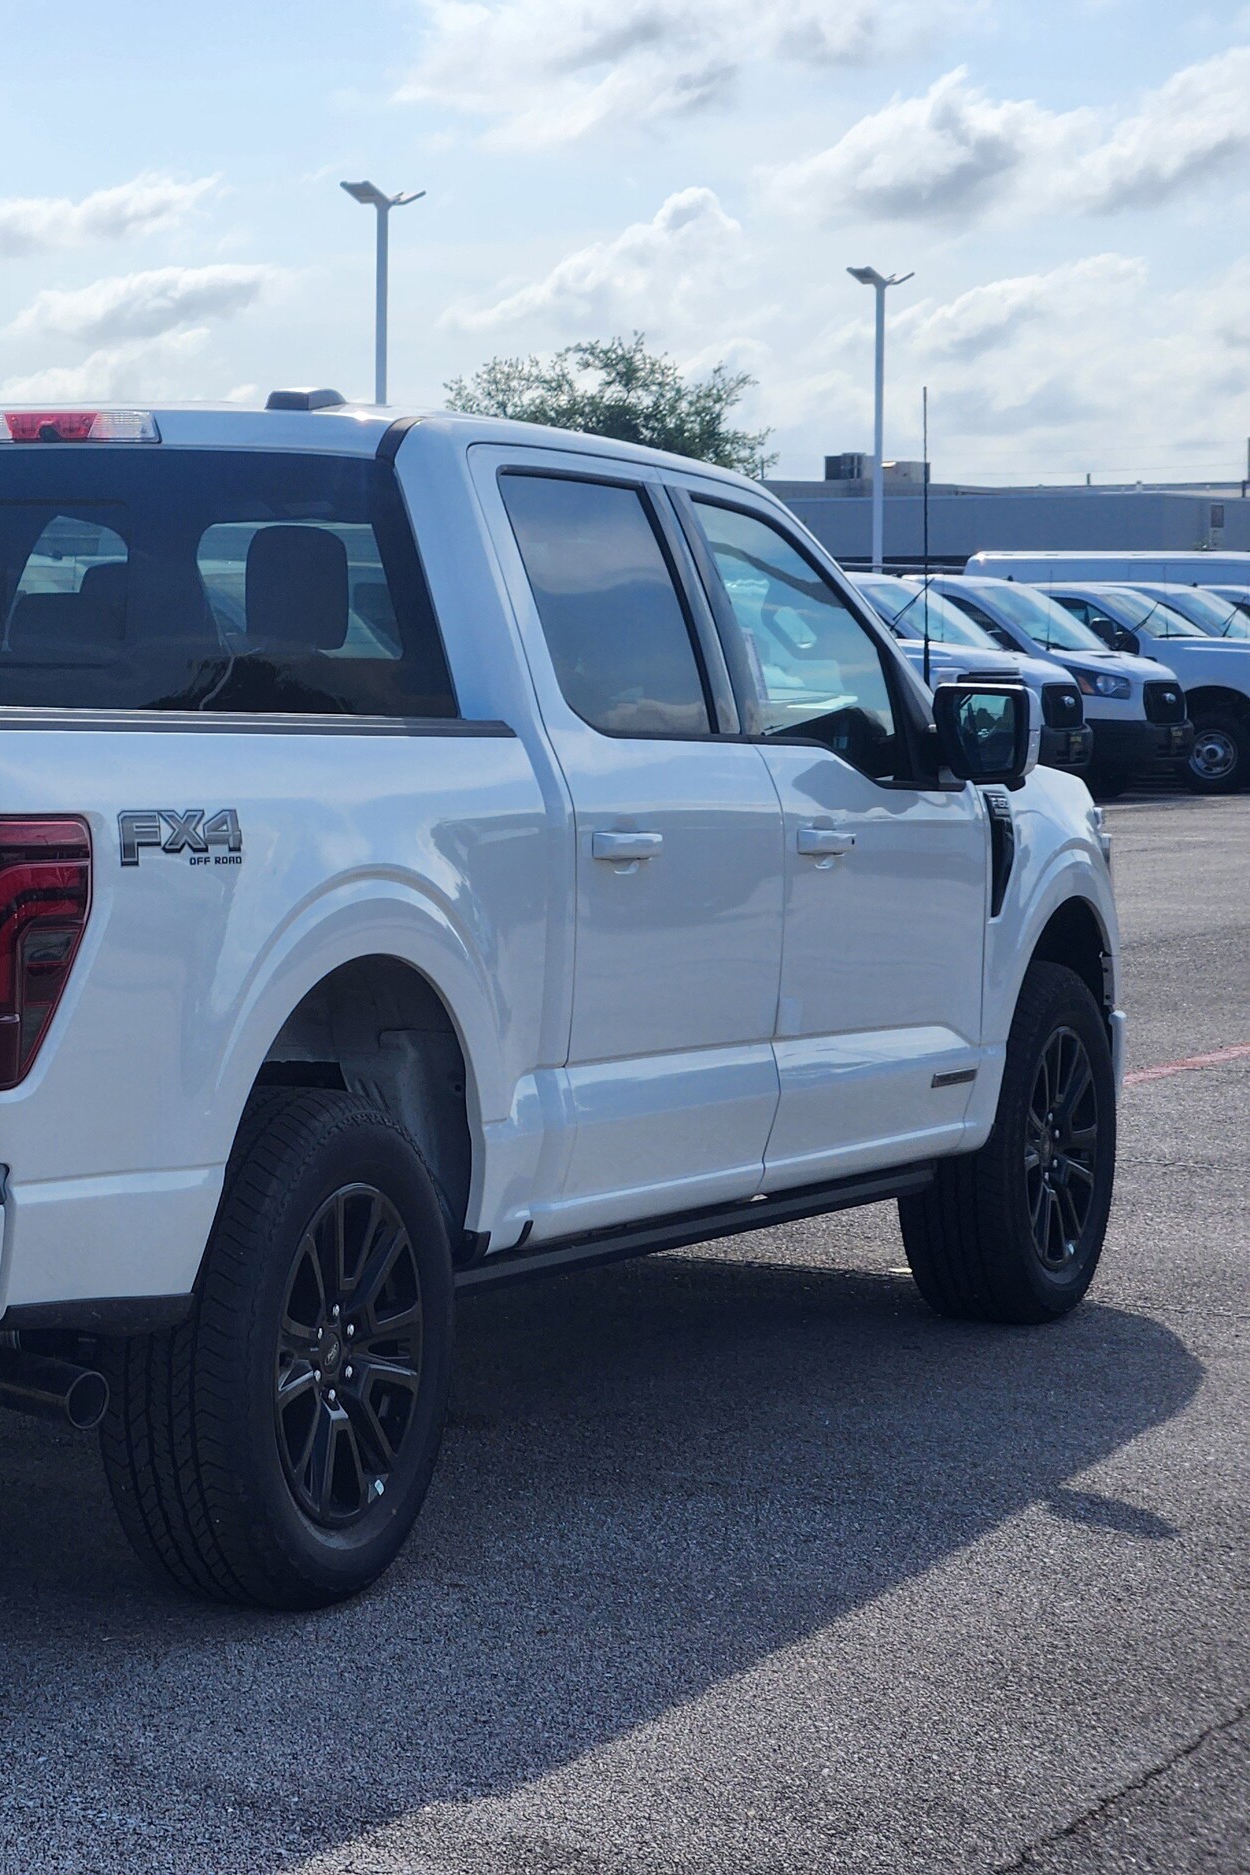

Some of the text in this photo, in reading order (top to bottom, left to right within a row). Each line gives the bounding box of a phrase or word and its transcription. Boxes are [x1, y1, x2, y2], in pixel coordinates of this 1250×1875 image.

[117, 809, 243, 867] FX4
[189, 855, 243, 866] OFF ROAD
